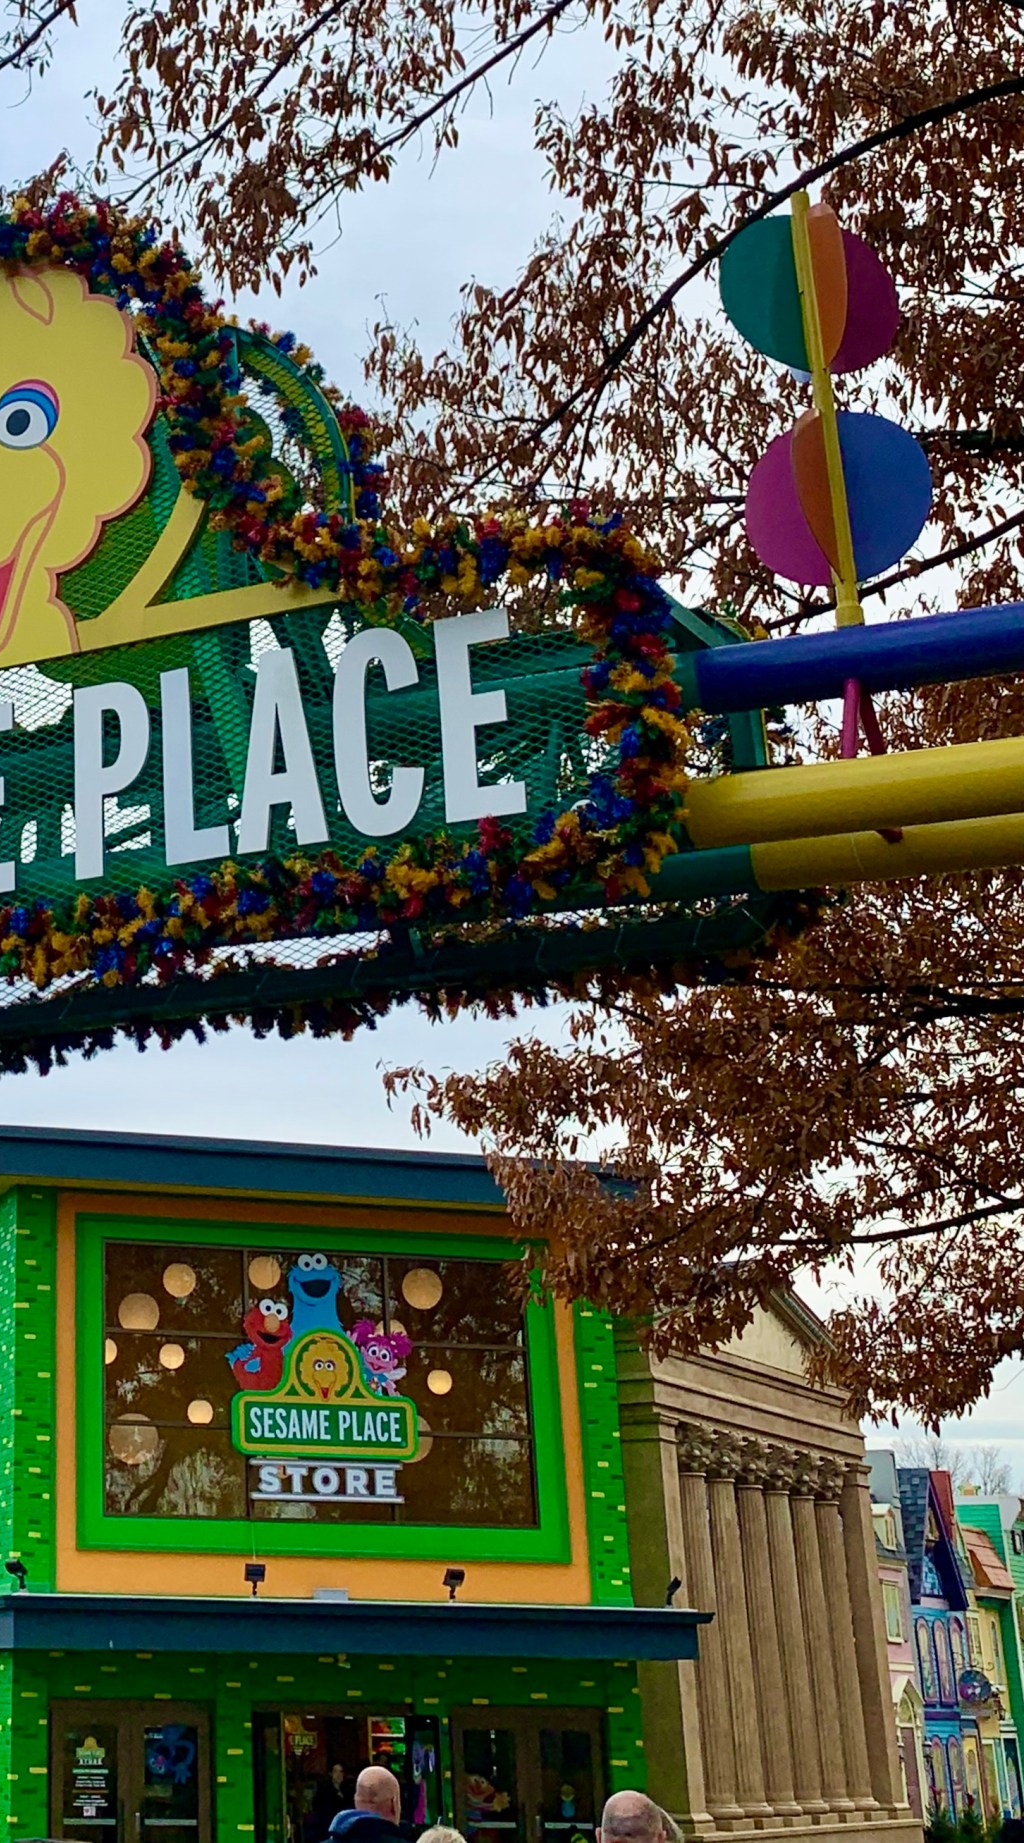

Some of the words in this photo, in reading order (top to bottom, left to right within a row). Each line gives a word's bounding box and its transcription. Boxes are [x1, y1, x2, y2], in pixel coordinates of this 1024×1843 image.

[73, 608, 527, 881] PLACE
[249, 1407, 331, 1440] SESAME
[338, 1411, 402, 1442] PLACE
[258, 1466, 396, 1495] STORE
